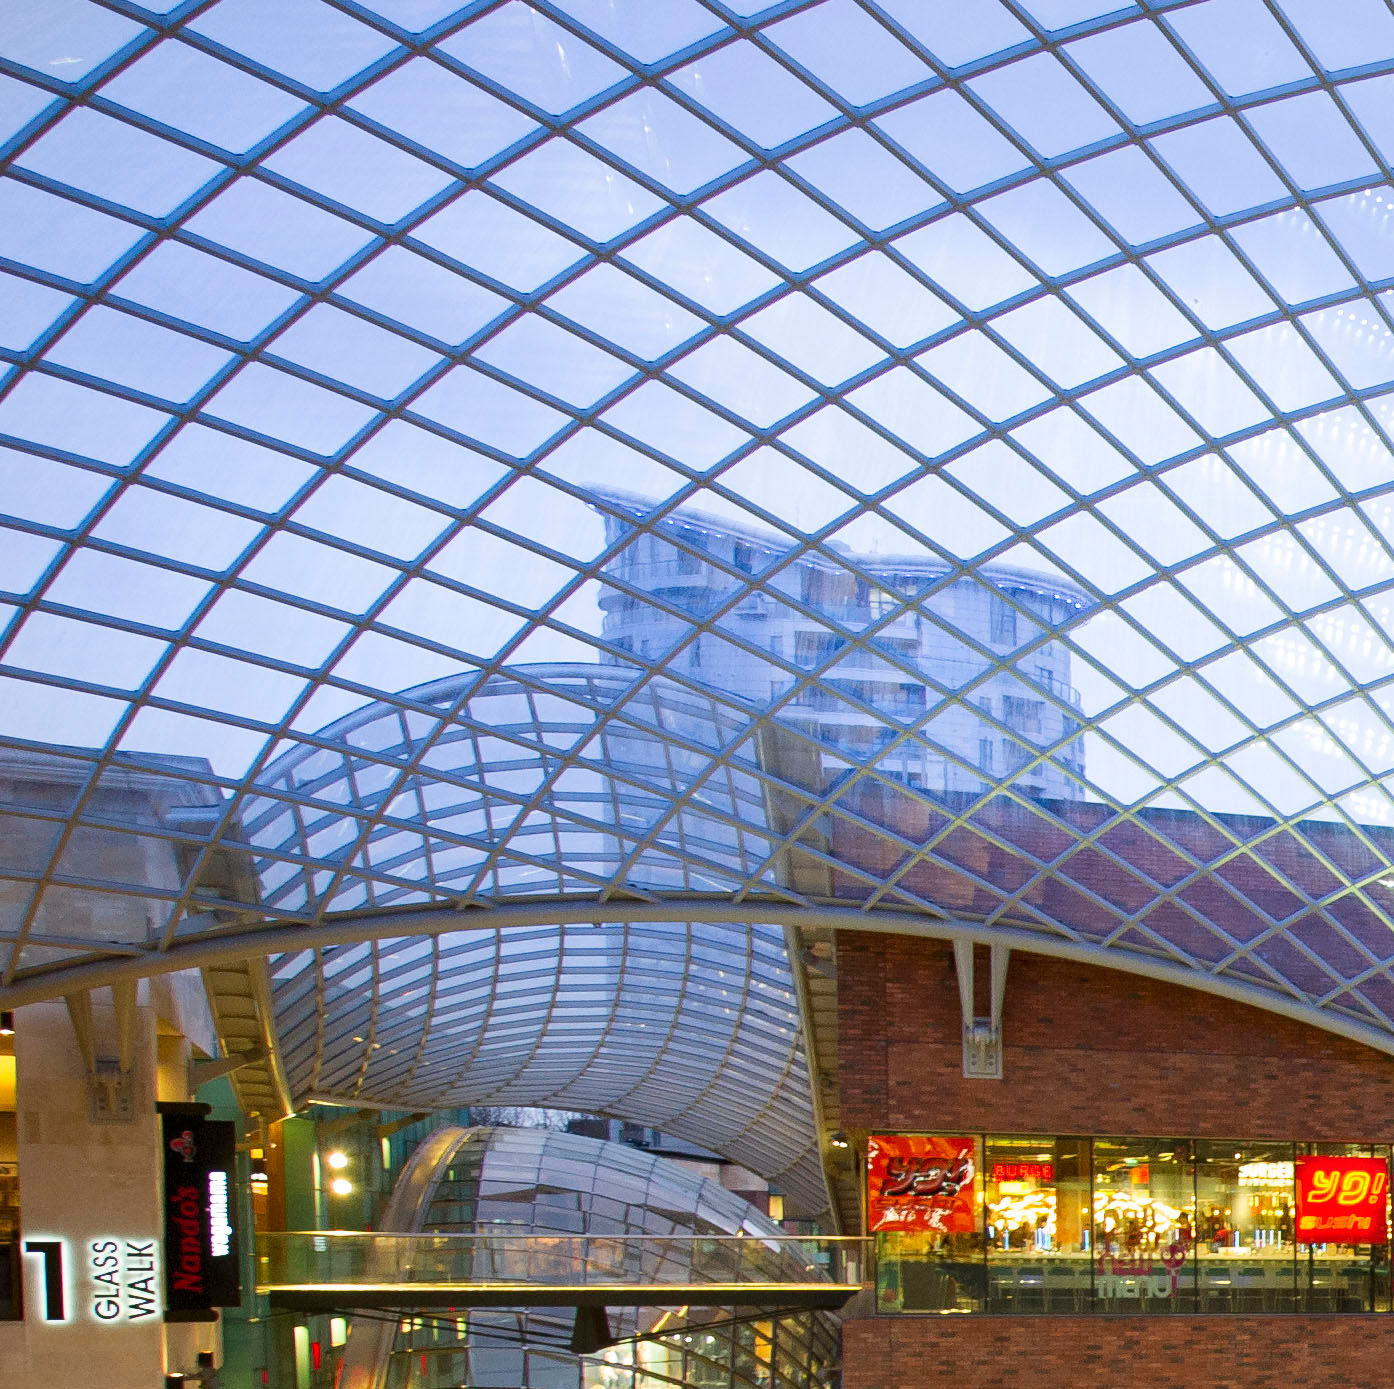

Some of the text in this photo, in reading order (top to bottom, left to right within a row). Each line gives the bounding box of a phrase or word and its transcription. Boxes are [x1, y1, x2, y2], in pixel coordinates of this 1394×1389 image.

[170, 1185, 203, 1293] Nando's
[25, 1241, 65, 1320] 1
[92, 1241, 120, 1320] GLASS
[127, 1242, 156, 1320] WALK
